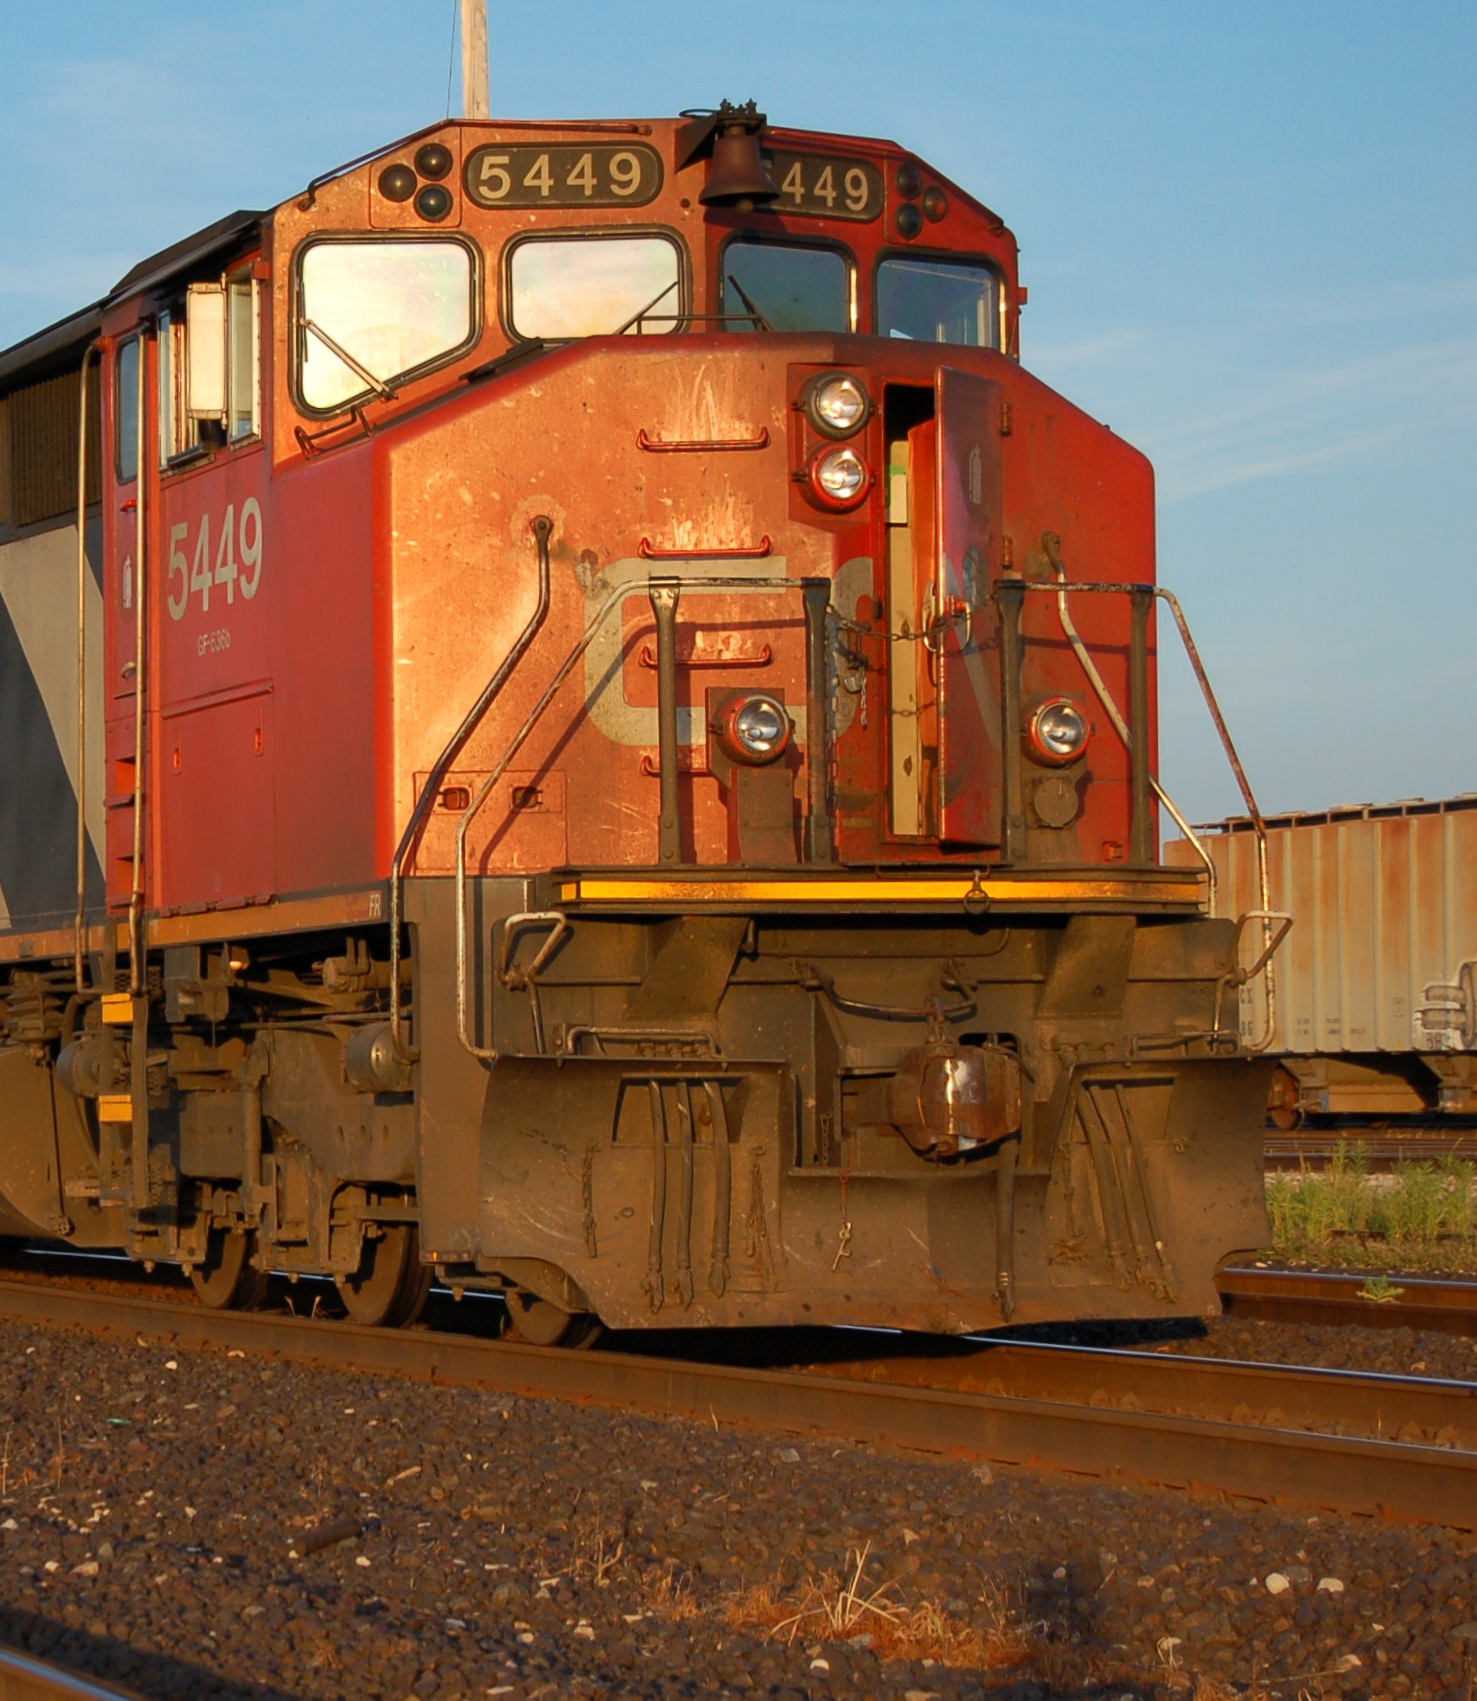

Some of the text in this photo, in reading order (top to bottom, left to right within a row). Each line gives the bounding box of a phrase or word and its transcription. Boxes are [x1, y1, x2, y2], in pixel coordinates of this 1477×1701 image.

[478, 152, 641, 199] 5449
[761, 160, 868, 212] 449
[167, 496, 263, 621] 5449
[369, 894, 381, 917] FR
